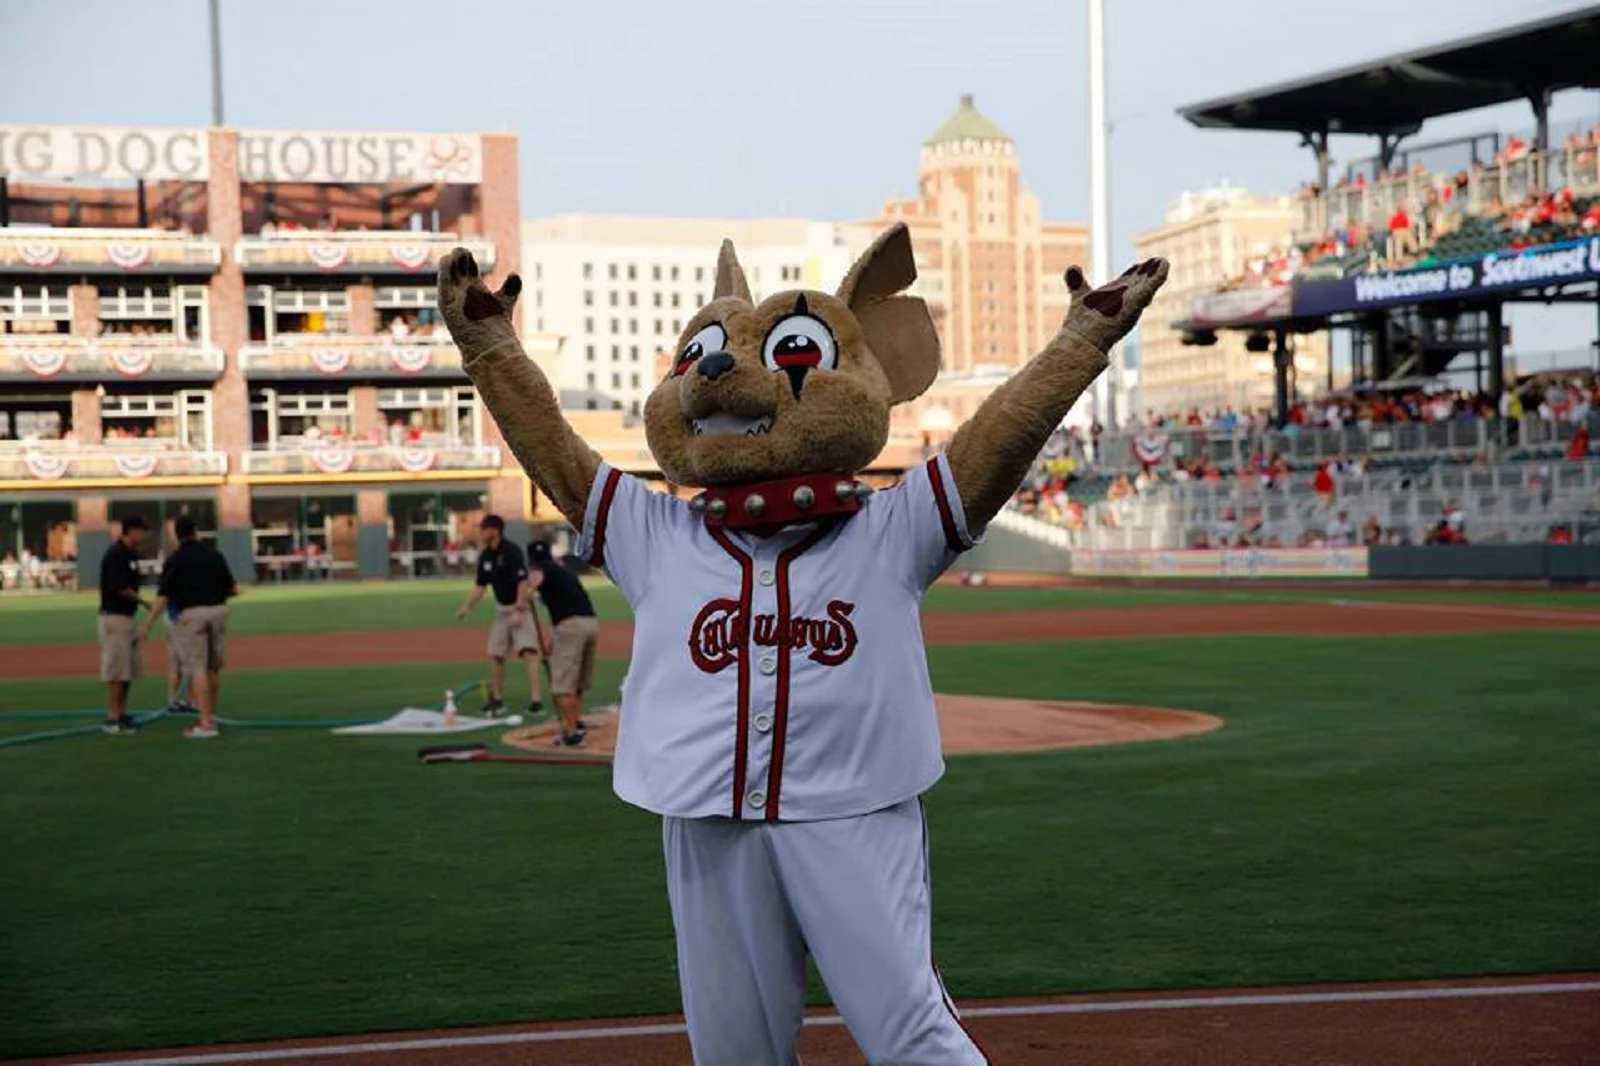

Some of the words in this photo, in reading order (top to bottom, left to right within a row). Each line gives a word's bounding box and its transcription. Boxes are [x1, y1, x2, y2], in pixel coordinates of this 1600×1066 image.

[72, 132, 201, 177] DOG
[239, 136, 414, 180] HOUSE
[1355, 267, 1448, 301] Welcome
[1450, 265, 1474, 290] to
